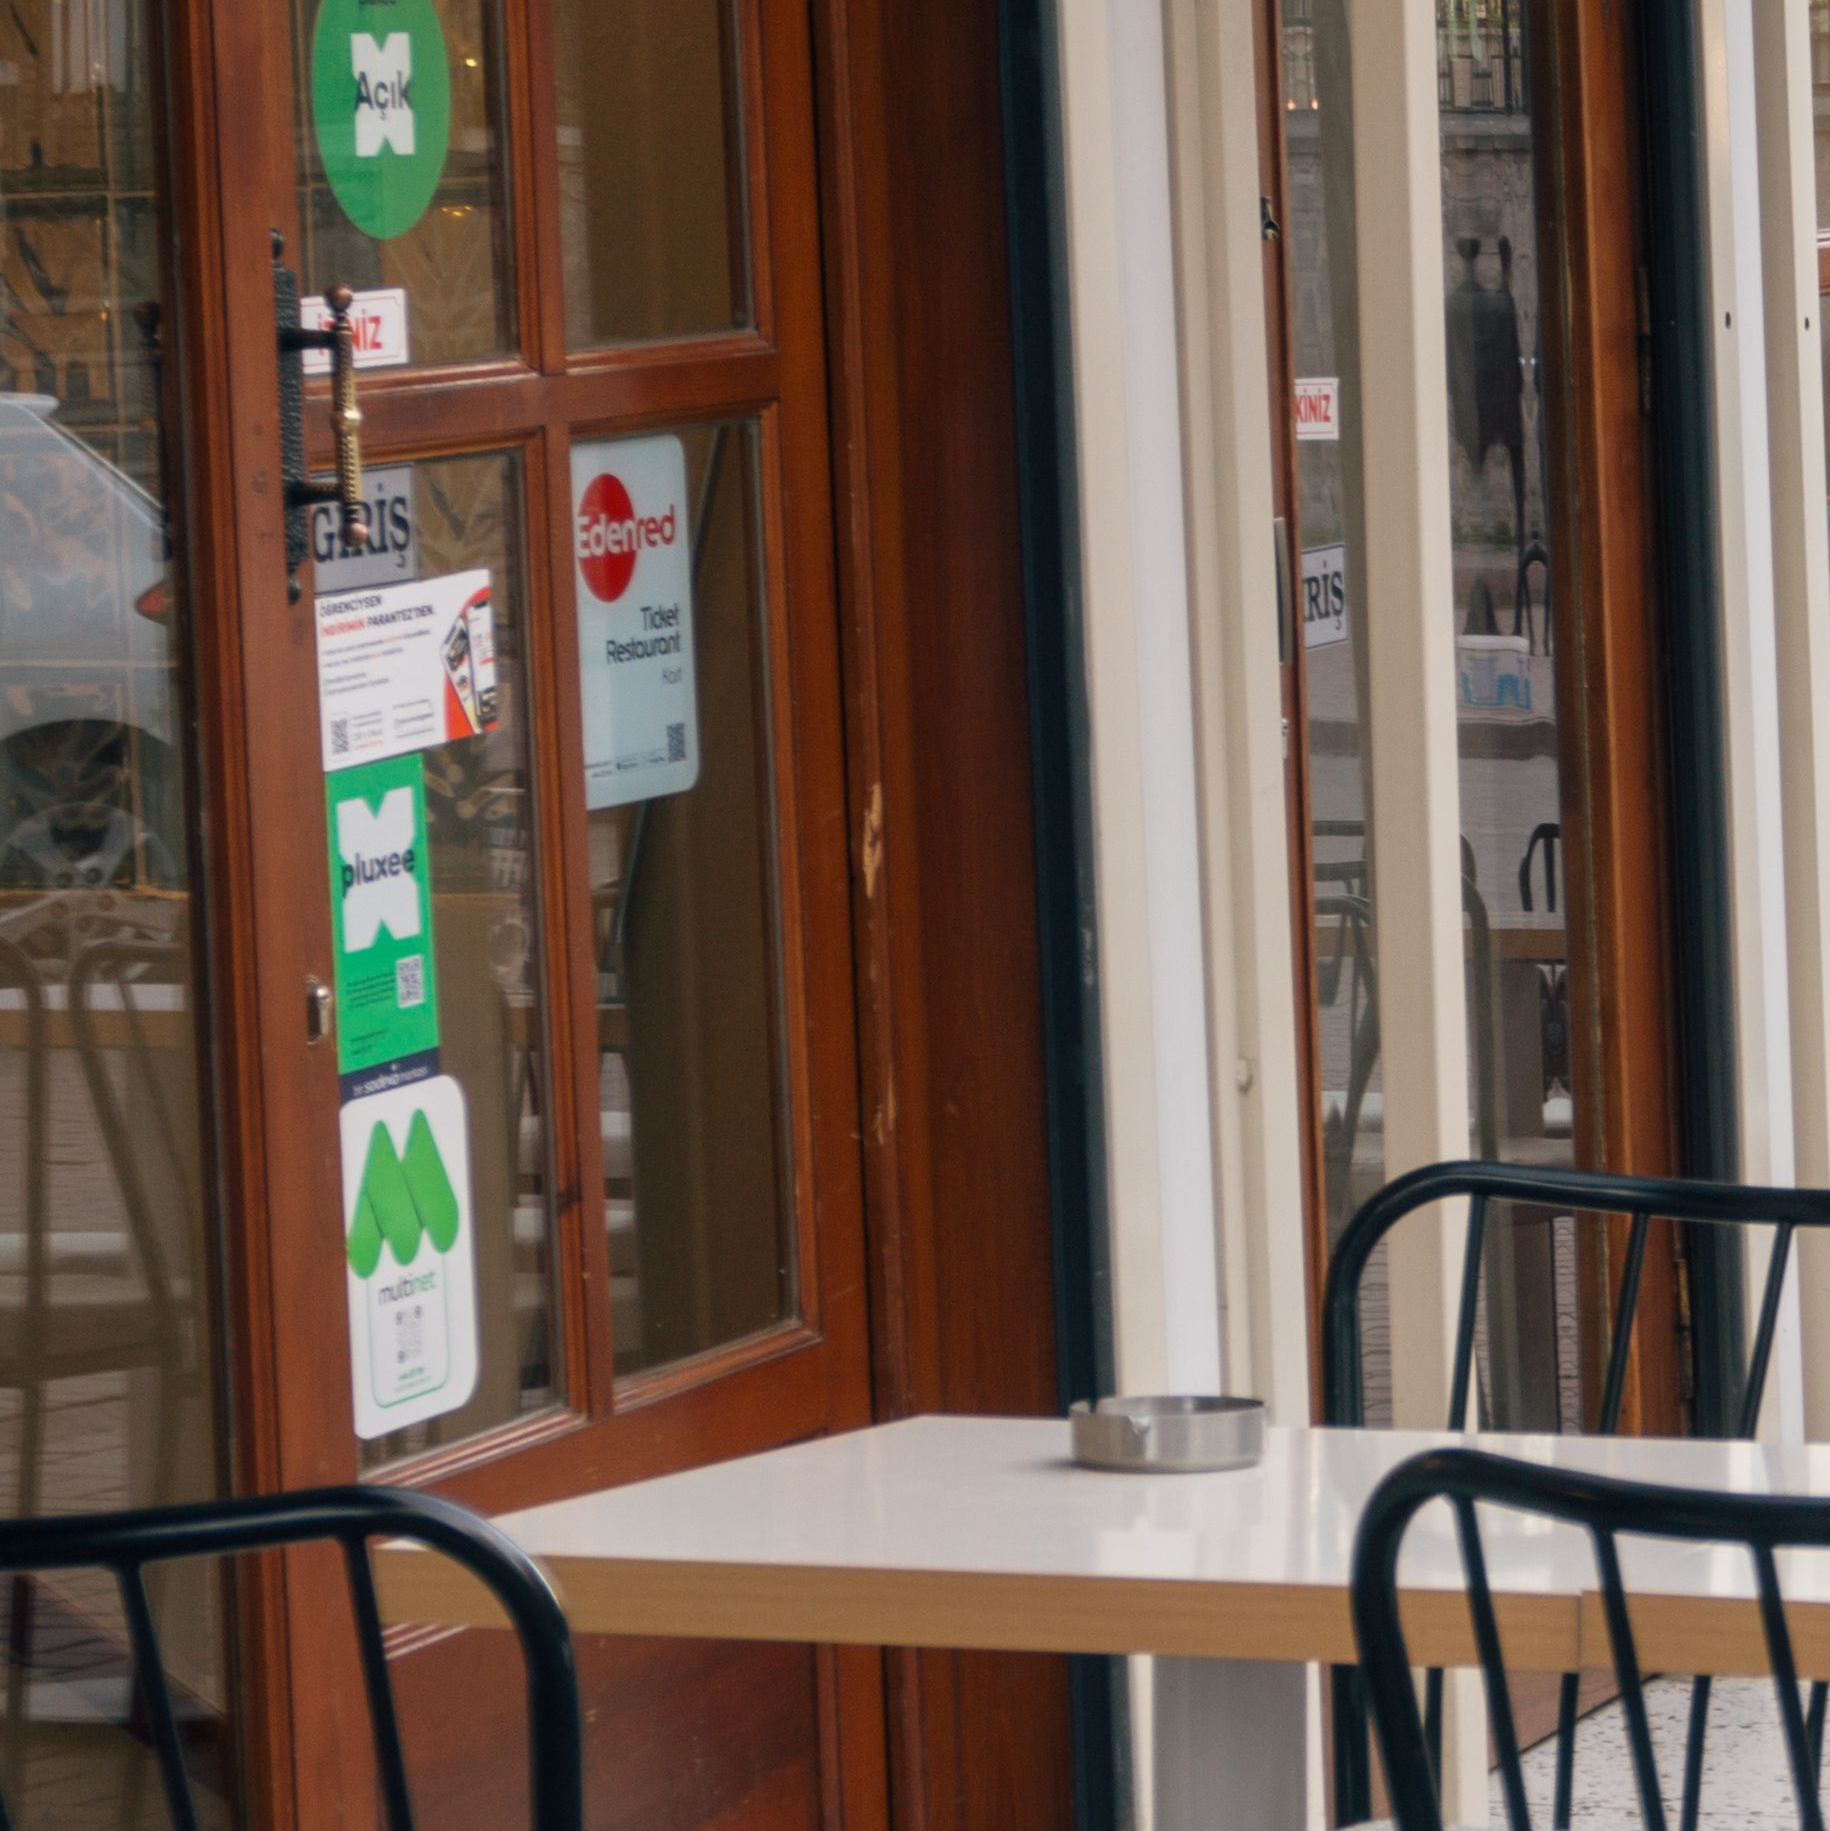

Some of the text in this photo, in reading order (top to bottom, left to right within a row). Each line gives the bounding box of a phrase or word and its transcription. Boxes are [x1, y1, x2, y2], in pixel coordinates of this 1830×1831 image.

[355, 70, 413, 121] Açık
[576, 503, 676, 559] Edenred
[640, 603, 681, 631] Ticket
[606, 631, 682, 665] Restaurant
[341, 848, 416, 899] pluxee
[378, 1269, 437, 1306] multinet
